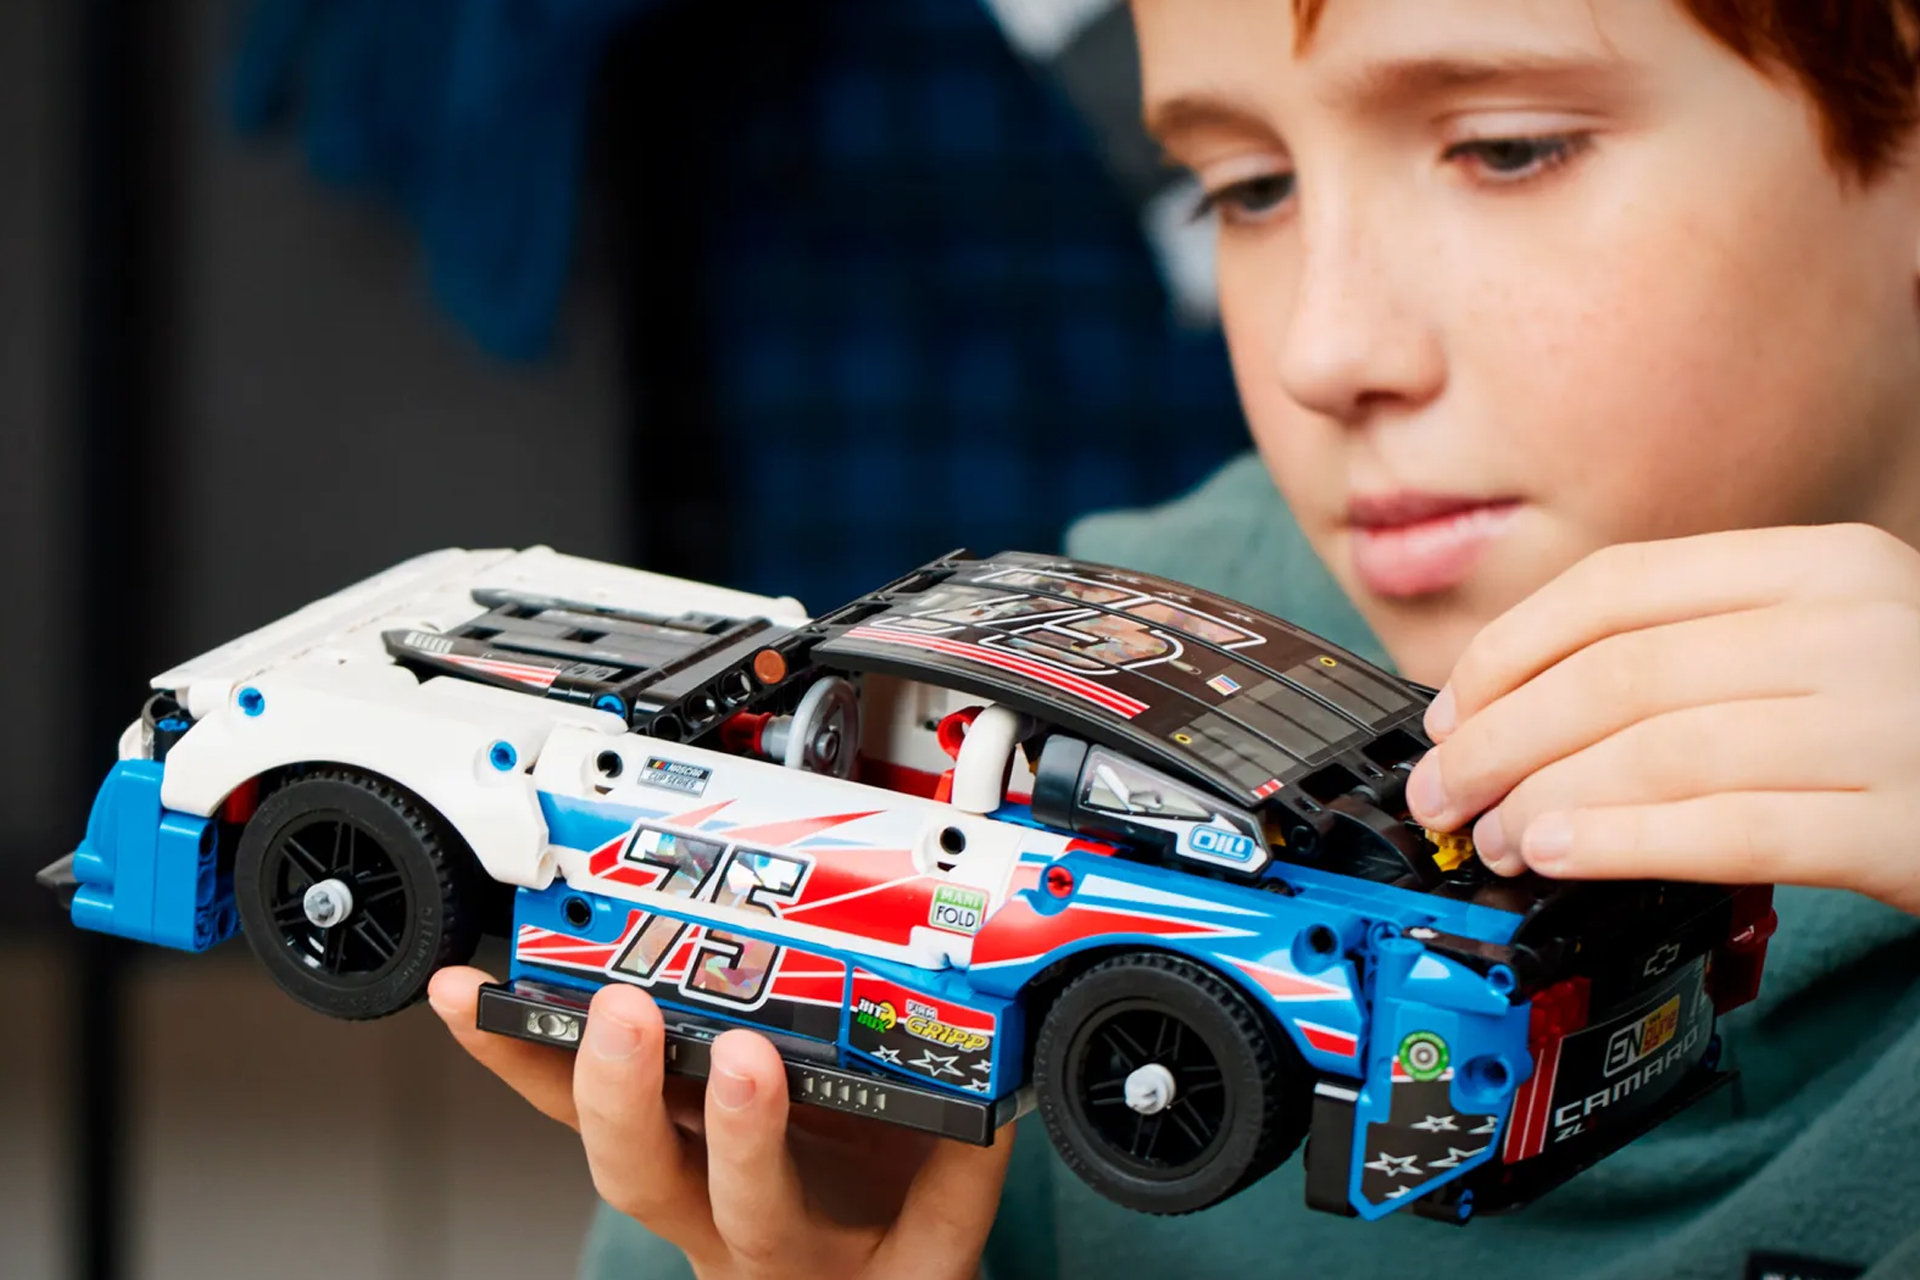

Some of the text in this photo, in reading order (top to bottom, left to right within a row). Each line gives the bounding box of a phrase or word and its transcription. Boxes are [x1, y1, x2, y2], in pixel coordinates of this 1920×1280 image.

[648, 770, 697, 789] CUP SERIES
[667, 762, 704, 779] NASCAR
[936, 904, 976, 928] FOLD
[858, 998, 889, 1019] BIT
[906, 1015, 988, 1050] GRIPP
[1554, 1026, 1698, 1129] CAMARO
